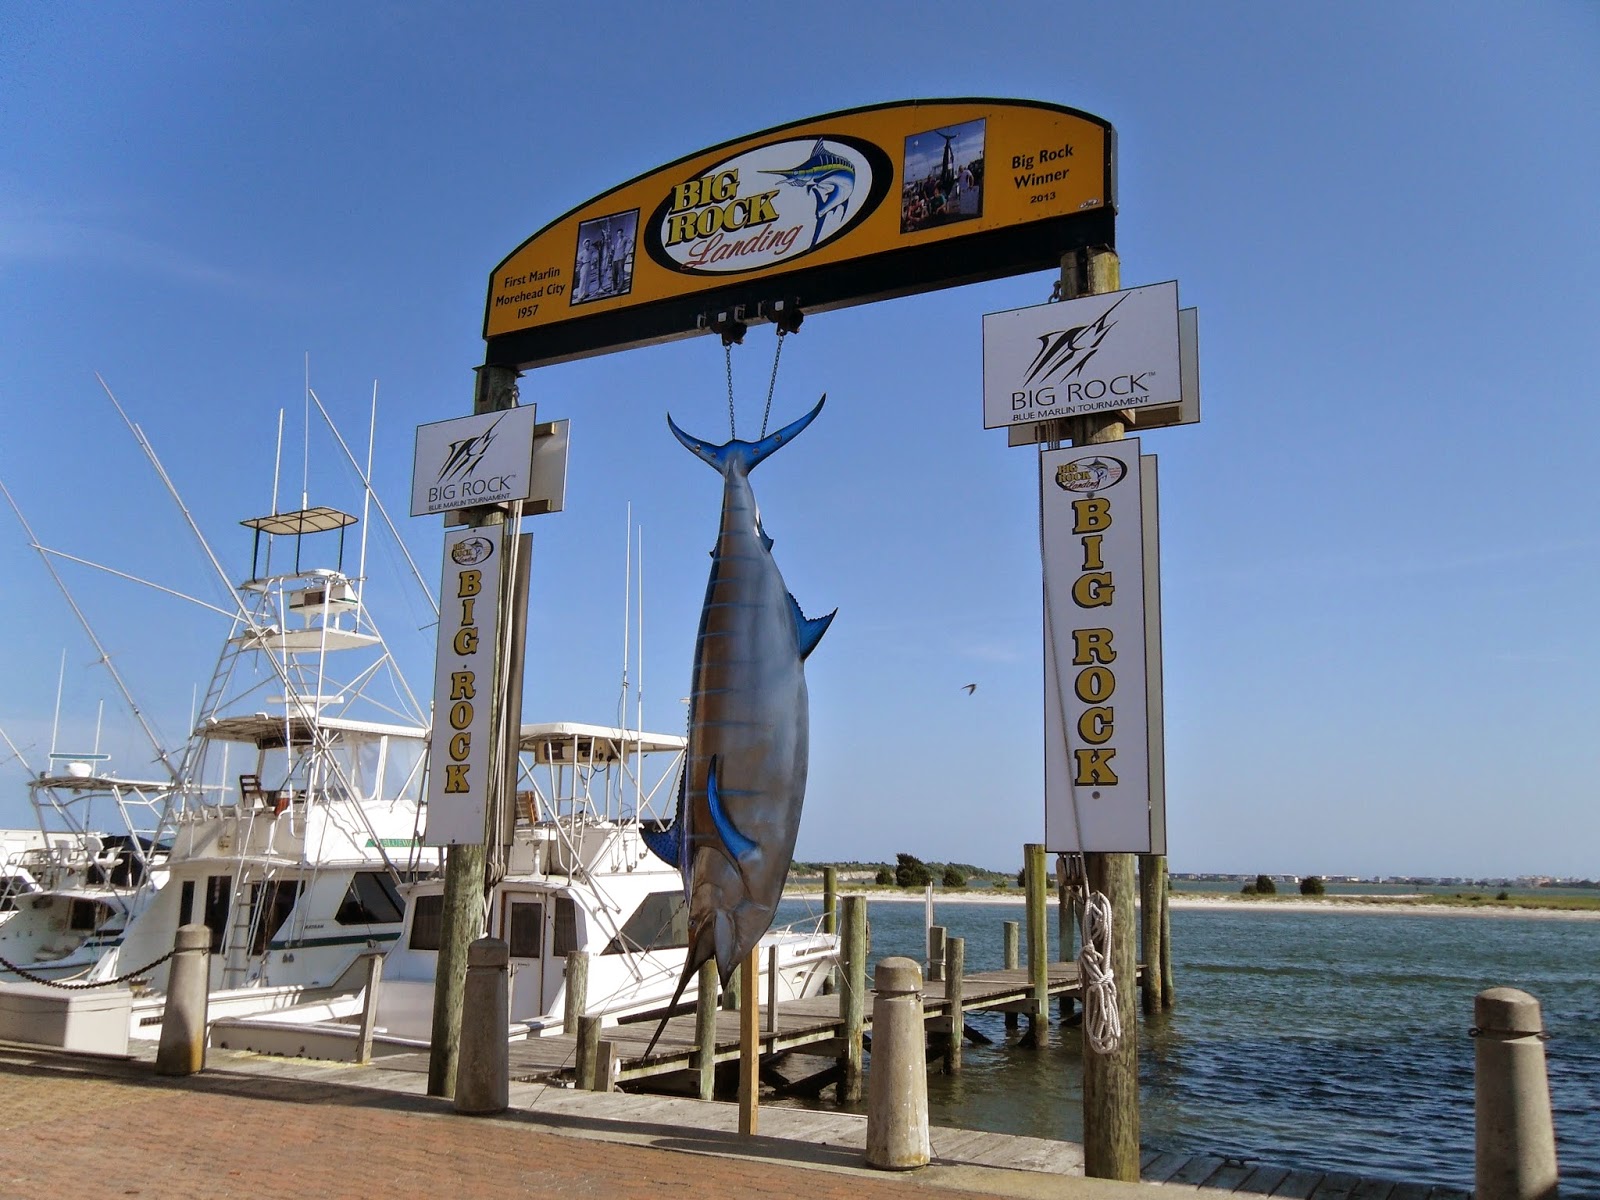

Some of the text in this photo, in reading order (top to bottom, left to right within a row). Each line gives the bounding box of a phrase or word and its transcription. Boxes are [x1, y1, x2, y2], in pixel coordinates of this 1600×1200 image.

[1012, 144, 1073, 170] Big Rock
[668, 168, 740, 215] BIG
[1014, 169, 1069, 189] Winner
[1030, 191, 1056, 204] 2013
[665, 189, 780, 248] ROCK
[681, 223, 803, 270] Landing
[505, 267, 560, 288] First Marlin
[495, 283, 565, 307] Morehead City
[518, 304, 539, 319] 1957
[1012, 387, 1056, 411] BIG
[1067, 372, 1149, 403] ROCK
[1012, 395, 1149, 422] BLUE MARLIN TOURNAMENT
[428, 475, 511, 503] BIG ROCK
[428, 493, 510, 512] BLUE MARLIN TOURNAMENT
[1071, 498, 1118, 786] BIG ROCK
[444, 569, 482, 793] BIG ROCK
